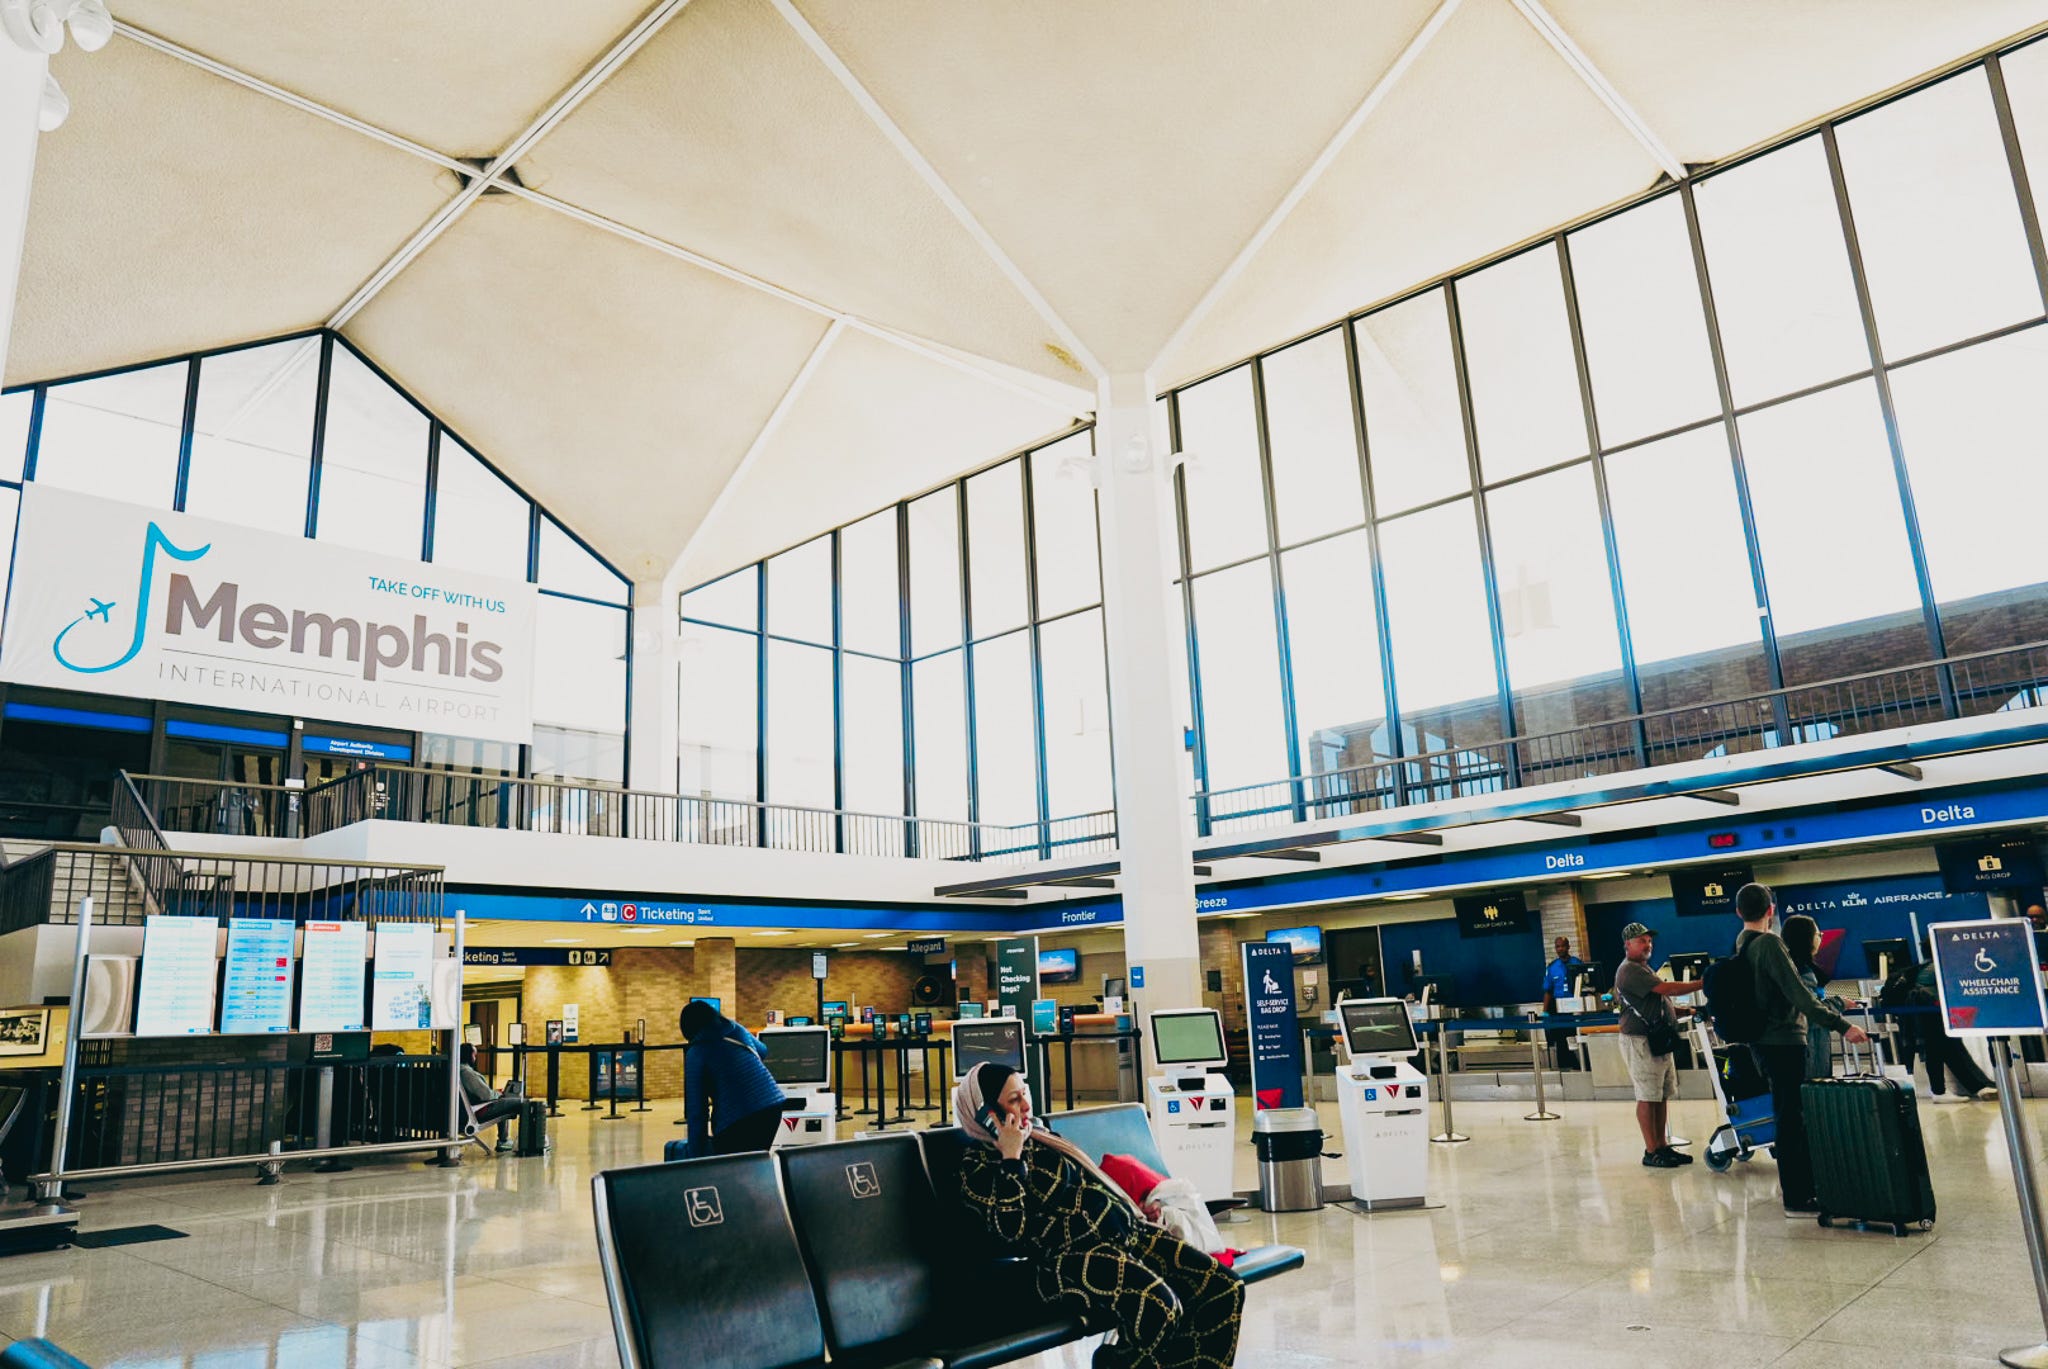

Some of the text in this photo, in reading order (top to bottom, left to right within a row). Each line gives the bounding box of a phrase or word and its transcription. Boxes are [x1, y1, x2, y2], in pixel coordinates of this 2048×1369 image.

[368, 576, 505, 613] TAKE OFF WITH US
[165, 573, 503, 682] Memphis
[159, 661, 501, 721] INTERNATIONAL AIRPORT
[329, 746, 385, 757] Development Division
[349, 742, 373, 750] Authority
[1921, 805, 1975, 824] Delta
[1545, 853, 1584, 869] Delta
[1842, 898, 1867, 907] KLM
[1874, 891, 1943, 905] AIRFRANCE
[1797, 901, 1836, 911] DELTA
[624, 906, 695, 923] C Ticketing
[1062, 910, 1097, 923] Frontier
[1963, 932, 2000, 940] DELTA
[910, 942, 942, 954] Allegiant
[1001, 975, 1031, 983] Checking
[1959, 977, 2020, 987] WHEELCHAIR
[1001, 985, 1020, 994] Bags?
[1963, 986, 2020, 996] ASSISTANCE
[1257, 999, 1289, 1007] SELF-SERVICE
